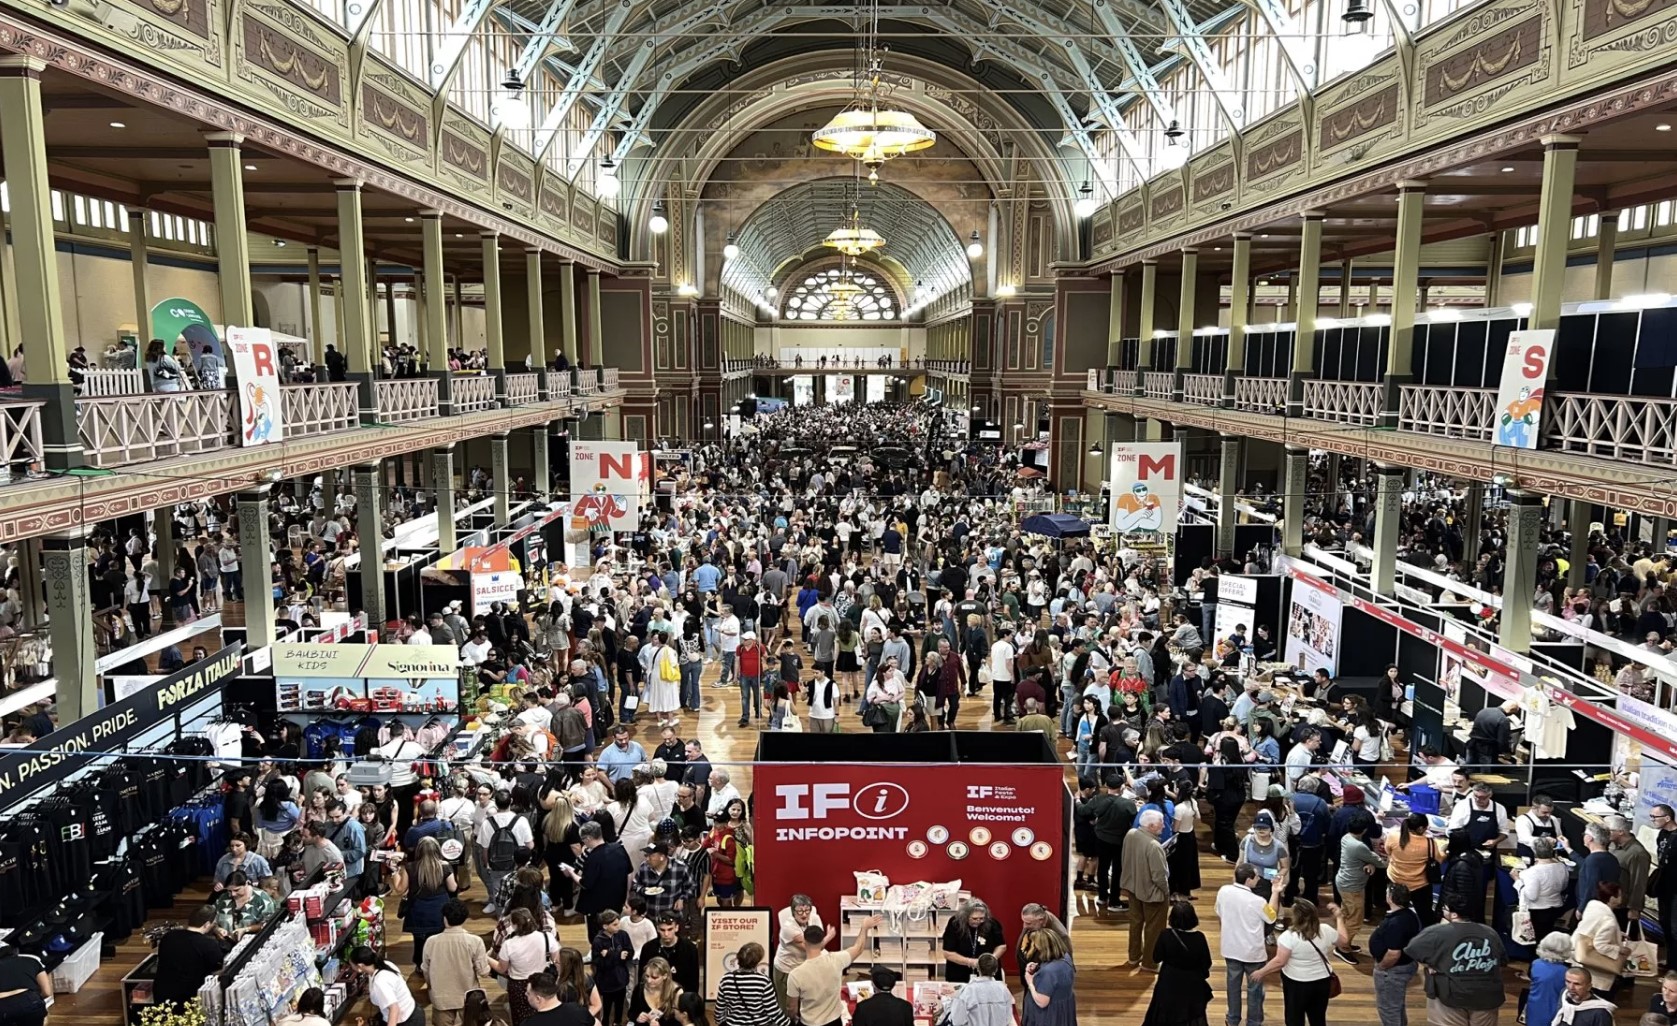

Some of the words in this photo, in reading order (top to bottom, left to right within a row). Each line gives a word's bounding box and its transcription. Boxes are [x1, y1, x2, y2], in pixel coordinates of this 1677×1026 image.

[252, 343, 275, 377] R
[1522, 345, 1546, 379] S
[1117, 454, 1136, 462] ZONE
[600, 453, 632, 479] N
[1138, 454, 1175, 480] M
[476, 584, 515, 595] SALSICCE
[1220, 580, 1247, 590] SPECIAL
[1220, 587, 1244, 596] OFFERS
[297, 661, 327, 670] KIDS
[387, 661, 449, 673] Signorina
[157, 671, 204, 710] FORZA
[205, 653, 238, 685] ITALIA
[1622, 703, 1641, 717] Italian
[1641, 711, 1668, 728] tradition
[18, 733, 91, 782] PASSION.
[92, 708, 138, 742] PRIDE.
[967, 786, 993, 799] IF
[776, 783, 850, 820] IF
[966, 805, 1035, 814] Benvenuto!
[966, 813, 1026, 822] Welcome!
[61, 822, 85, 841] FBI
[776, 827, 908, 841] INFOPOINT
[1452, 938, 1491, 961] Club
[1450, 961, 1465, 973] de
